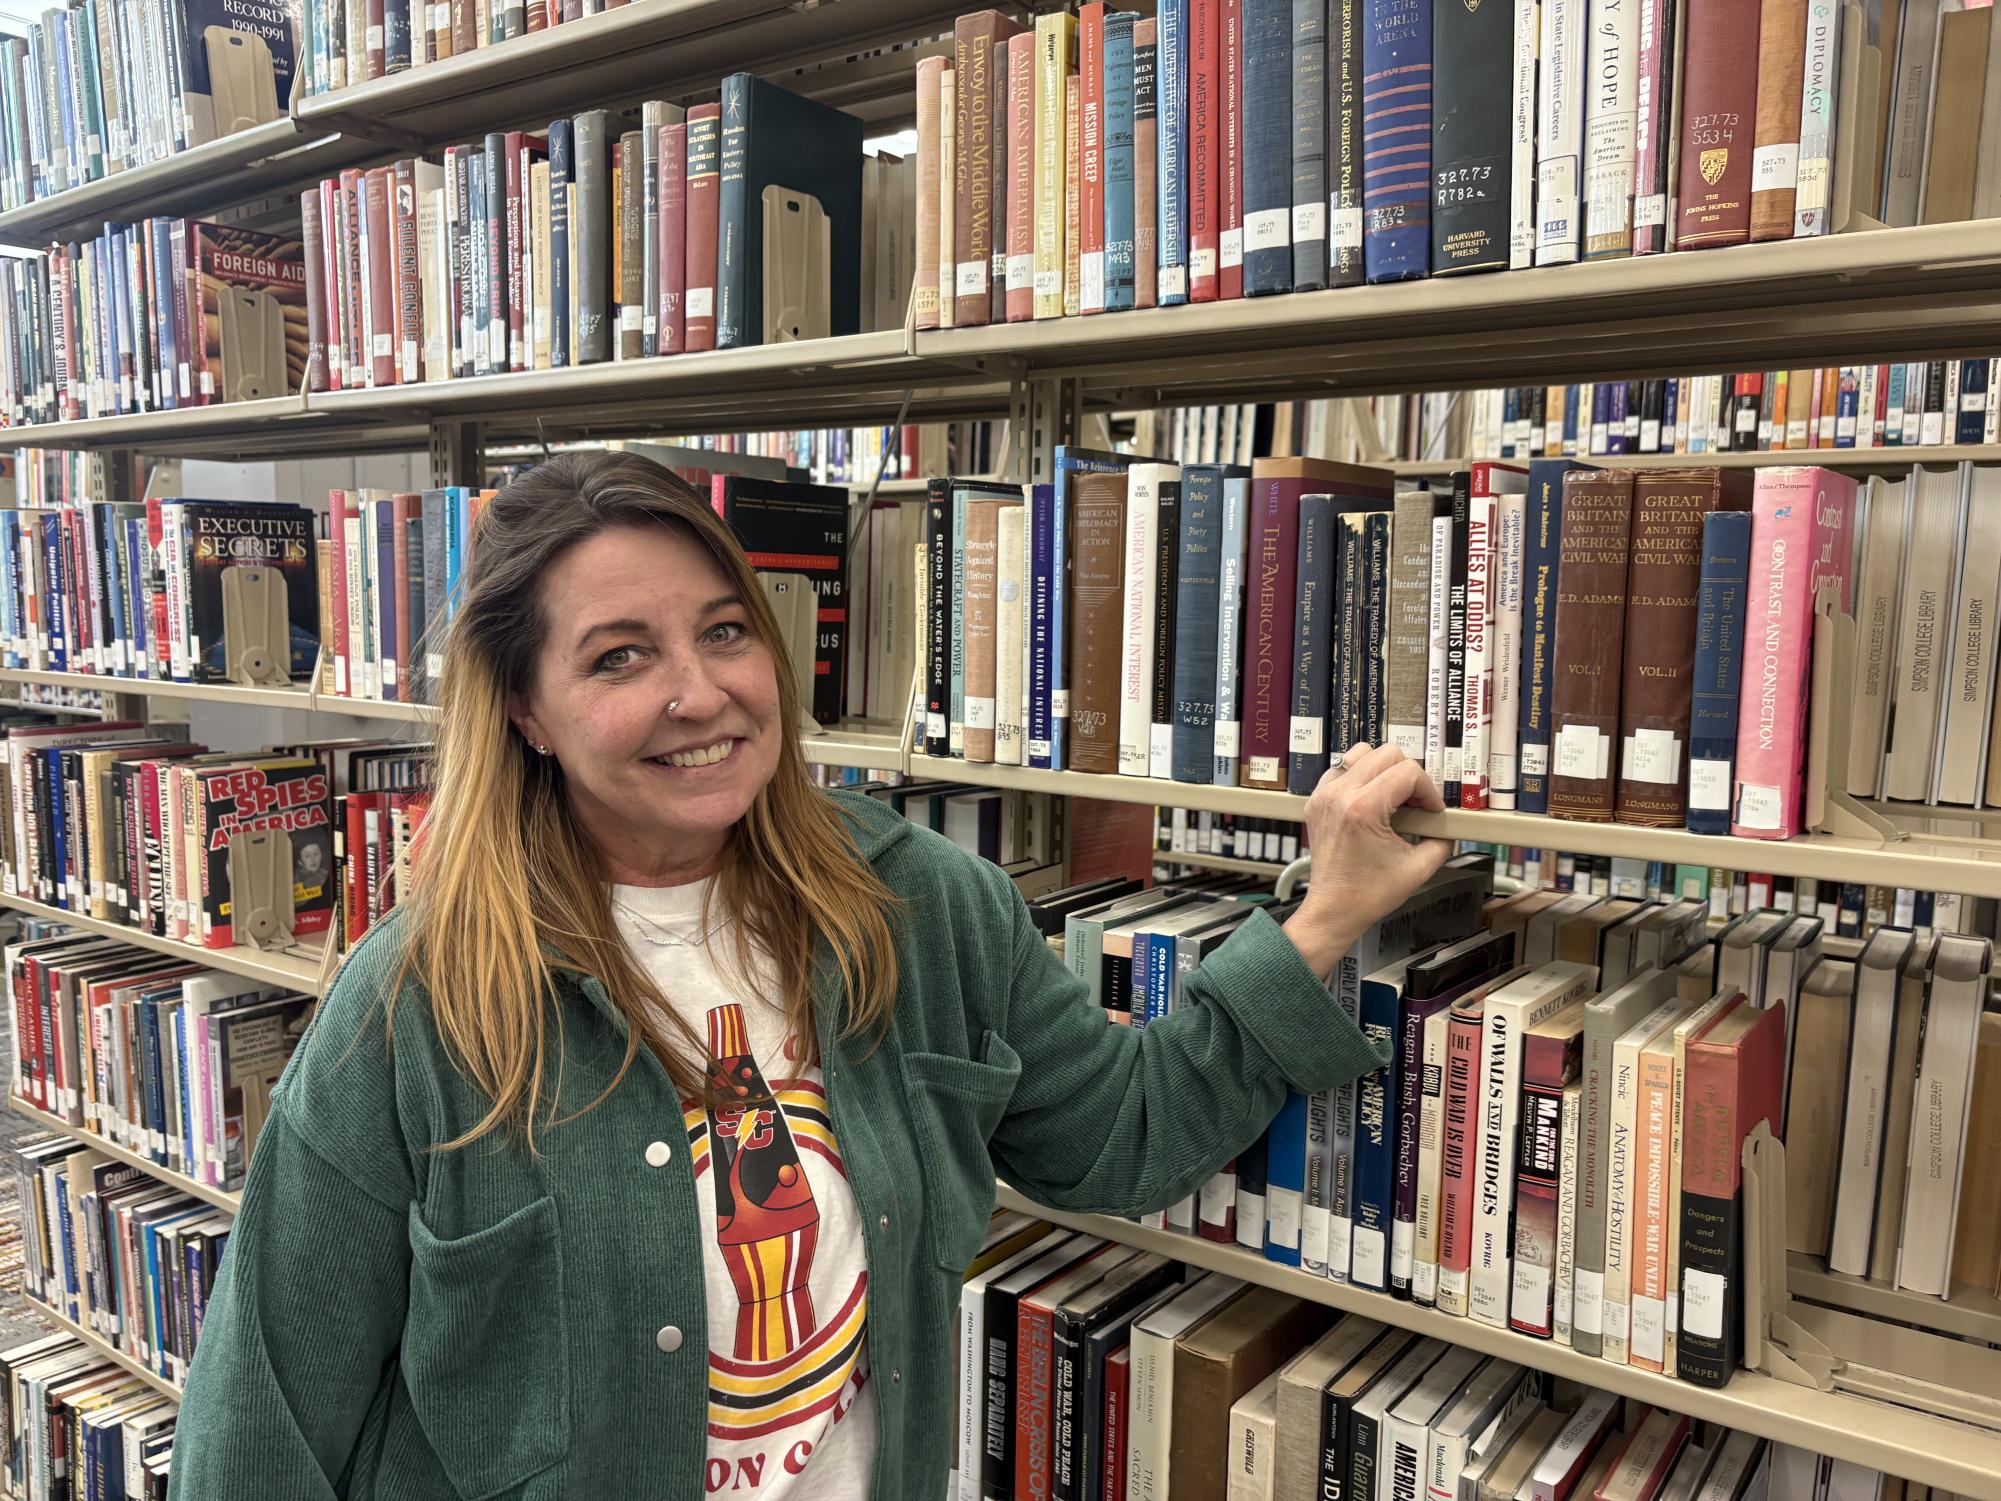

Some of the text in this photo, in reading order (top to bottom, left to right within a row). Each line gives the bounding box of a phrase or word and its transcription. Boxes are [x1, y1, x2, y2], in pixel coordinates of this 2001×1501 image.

[224, 0, 284, 24] RECORD
[970, 34, 989, 91] Envoy
[1598, 23, 1619, 109] of HOPE
[1810, 26, 1827, 115] DIPLOMACY
[972, 94, 988, 110] to
[1017, 50, 1030, 139] AMERICAN
[957, 40, 968, 194] Ambassador George McGhee
[972, 113, 988, 143] the
[1084, 102, 1097, 183] MISSION CREEP
[1195, 73, 1206, 231] AMERICA RECOMMITTED
[1228, 150, 1235, 158] IN
[971, 146, 988, 208] Middle
[1438, 167, 1492, 185] 327.73
[1017, 146, 1029, 255] IMPERIALISM
[1685, 202, 1740, 216] JOHNS HOPKINS
[401, 221, 416, 275] SILENT
[489, 218, 500, 277] BEYOND
[1442, 238, 1491, 251] UNIVERSITY
[1447, 230, 1485, 242] HARVARD
[1452, 248, 1479, 258] PRESS
[213, 253, 276, 278] FOREIGN
[282, 264, 304, 281] AID
[1268, 482, 1279, 516] WHITE
[1453, 489, 1465, 523] MICHTA
[1640, 511, 1706, 522] BRITAIN
[1645, 495, 1703, 508] GREAT
[198, 517, 306, 536] EXECUTIVE
[200, 536, 307, 558] SECRETS
[1306, 518, 1314, 563] WILLIAMS
[1644, 526, 1698, 534] AND THE
[935, 534, 943, 579] BEYOND
[1634, 554, 1670, 565] CIVIL
[935, 584, 943, 605] THE
[1223, 558, 1235, 601] Selling
[1301, 581, 1316, 621] Empire
[1466, 521, 1486, 653] ALLIES AT ODDS?
[1127, 510, 1146, 703] AMERICAN NATIONAL INTEREST
[935, 610, 943, 652] WATER'S
[1221, 606, 1234, 681] Intervention
[1255, 525, 1279, 743] THE AMERICAN CENTURY
[1302, 624, 1312, 636] as
[1339, 540, 1356, 753] WILLIAMS THE TRAGEDY OF AMERICAN DIPLOMACY
[1528, 565, 1549, 730] Prologue to Manifest Destiny
[1759, 539, 1787, 750] CONTRAST AND CONNECTION
[1963, 598, 1983, 702] SIMPSON COLLEGE LIBRARY
[1034, 576, 1046, 740] DEFINING THE NATIONAL INTEREST
[1298, 651, 1312, 675] Way
[1447, 585, 1464, 721] THE LIMITS OF ALLIANCE
[1221, 686, 1231, 696] &
[1298, 695, 1310, 717] Life
[1300, 679, 1311, 691] of
[1178, 702, 1215, 714] 327.73
[1183, 716, 1208, 726] W52
[208, 770, 267, 802] RED
[235, 774, 328, 817] SPIES
[209, 805, 328, 852] AMERICA
[219, 814, 239, 828] IN
[367, 846, 376, 893] HAUNTED
[40, 1006, 53, 1055] INTERCEPT
[1399, 1013, 1420, 1187] Reagan, Bush, Gorbachev
[1421, 1065, 1439, 1097] KABUL
[1617, 1064, 1631, 1099] Nincic
[1445, 1056, 1470, 1179] COLD WAR IS OVER
[1523, 1095, 1536, 1167] MELVYN P. LEFFLER
[1534, 1098, 1558, 1170] MANKIND
[1584, 1069, 1600, 1208] CRACKING THE MONOLITH
[1482, 1014, 1508, 1269] OF WALLS AND BRIDGES KOVRIG
[1645, 1090, 1665, 1253] PEACE IMPOSSIBLE-WAR
[1559, 1137, 1576, 1284] REAGAN AND GORBACHEV
[1609, 1123, 1629, 1272] ANATOMY HOSTILITY
[1687, 1207, 1725, 1223] Dangers
[1684, 1239, 1725, 1256] Prospects
[1695, 1228, 1715, 1238] and
[1680, 1362, 1720, 1379] HARPER
[966, 1394, 972, 1405] TO
[987, 1337, 1007, 1461] HANG SEPARATELY
[1061, 1359, 1073, 1486] COLD WAR, COLD PEACE
[1244, 1428, 1255, 1476] GRISWOLD
[1435, 1443, 1446, 1487] Macdonald
